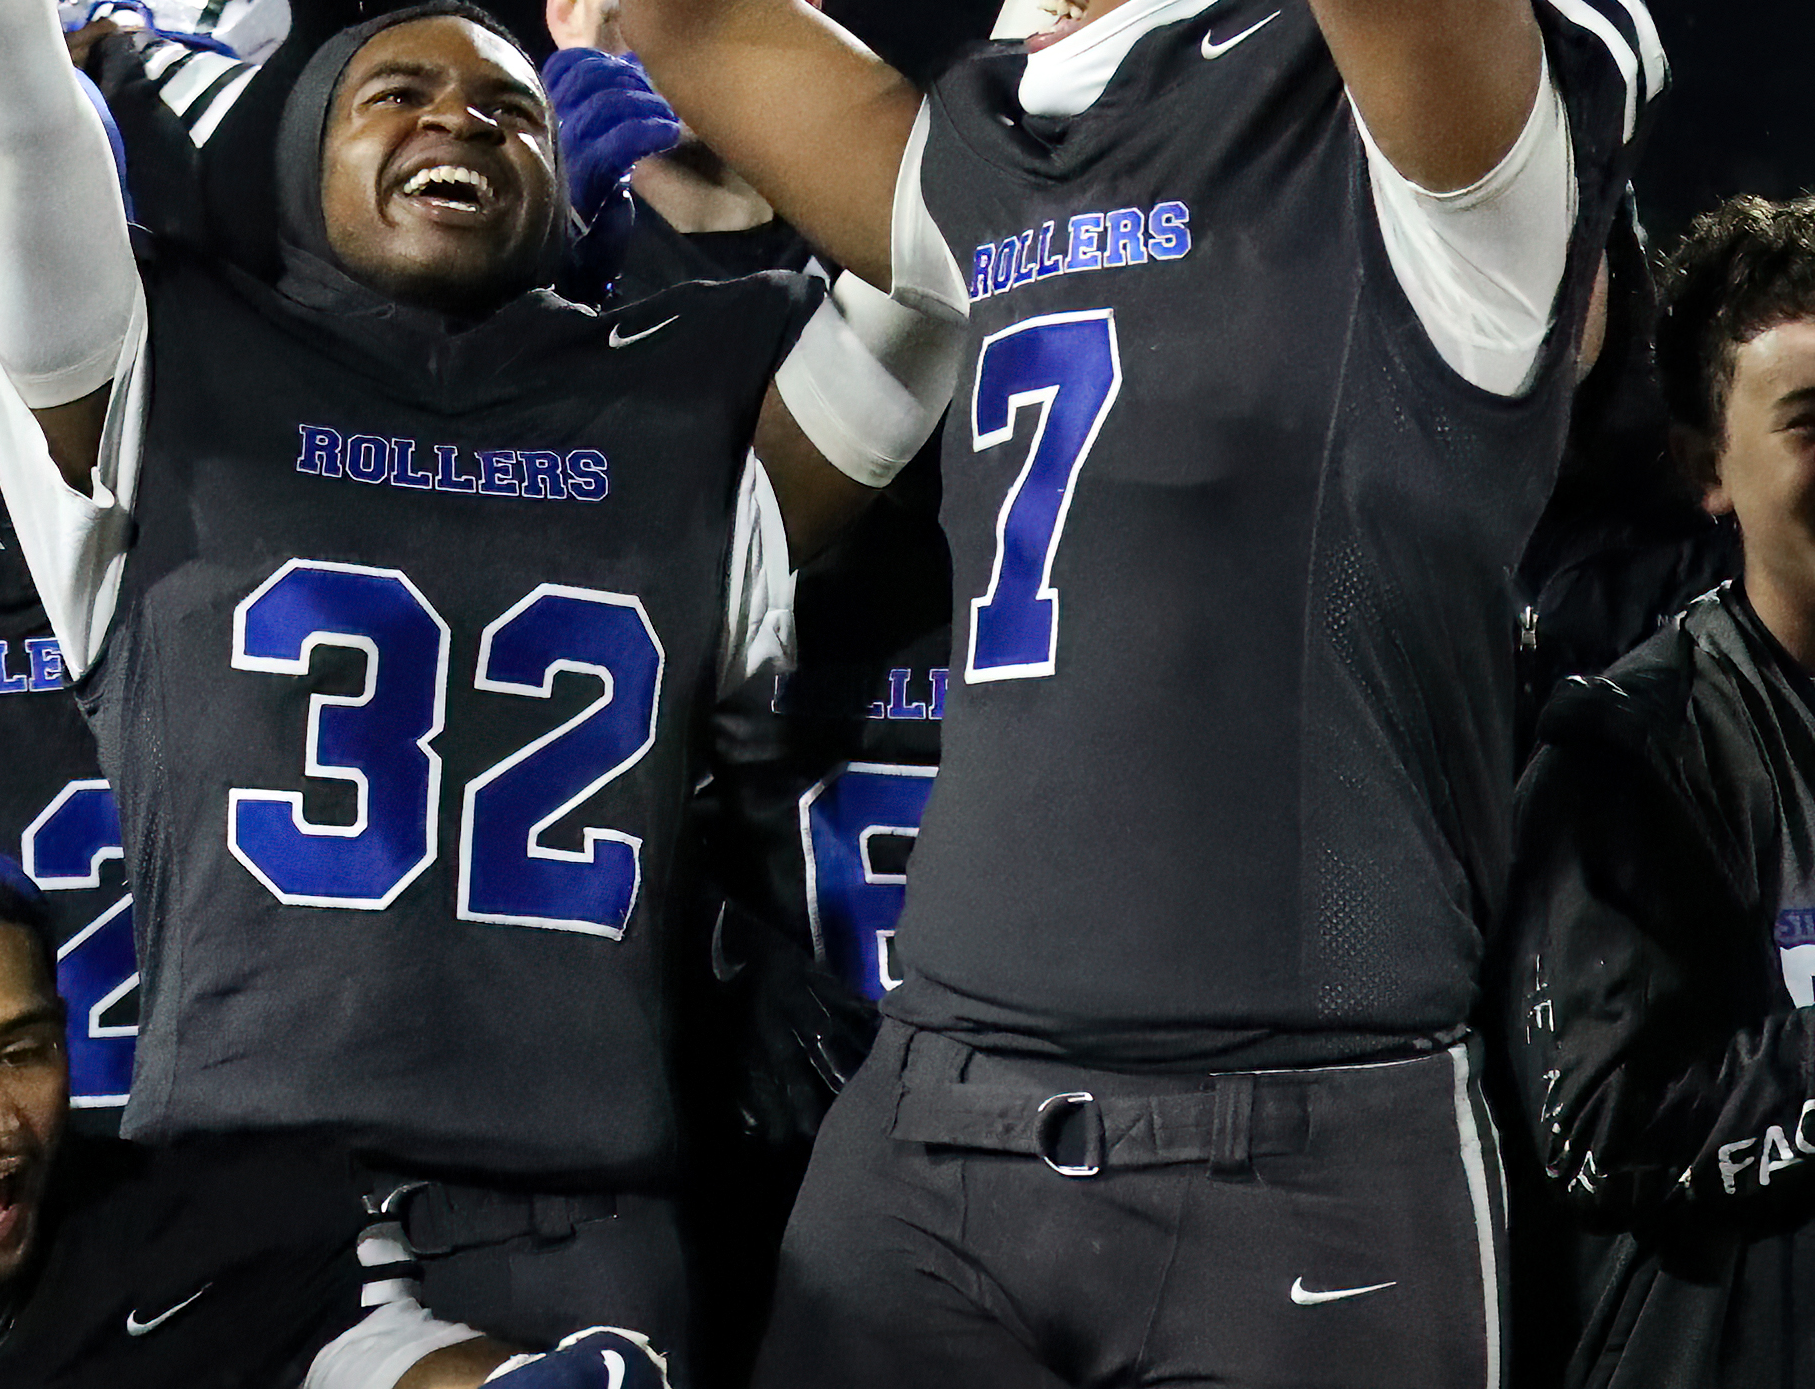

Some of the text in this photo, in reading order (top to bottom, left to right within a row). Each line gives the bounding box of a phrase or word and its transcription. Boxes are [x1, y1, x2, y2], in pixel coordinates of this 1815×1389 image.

[969, 200, 1192, 303] ROLLERS
[296, 423, 610, 503] ROLLERS
[964, 307, 1122, 685] 7
[227, 556, 667, 941] 32
